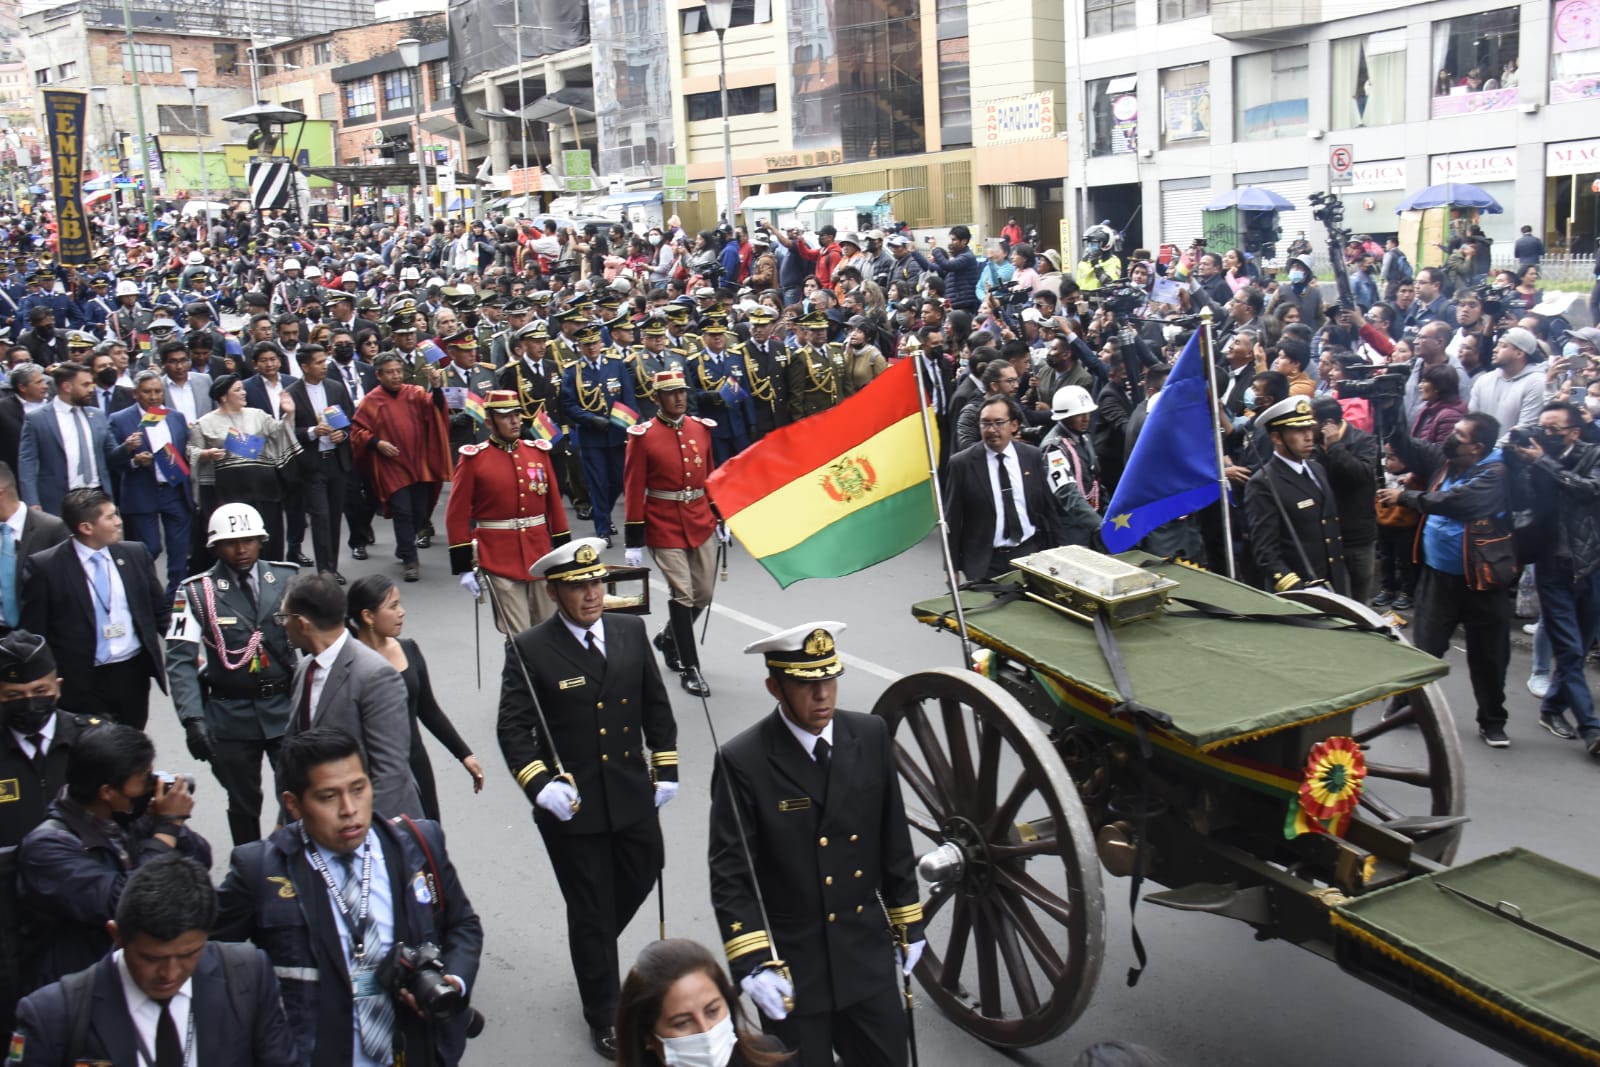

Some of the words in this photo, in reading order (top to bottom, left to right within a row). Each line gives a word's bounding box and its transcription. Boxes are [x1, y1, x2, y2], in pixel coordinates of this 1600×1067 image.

[997, 102, 1040, 133] PARQUEO
[1353, 166, 1404, 180] AGICA
[1435, 155, 1514, 172] MAGICA
[55, 112, 82, 240] EMMFAB
[228, 514, 251, 533] PM
